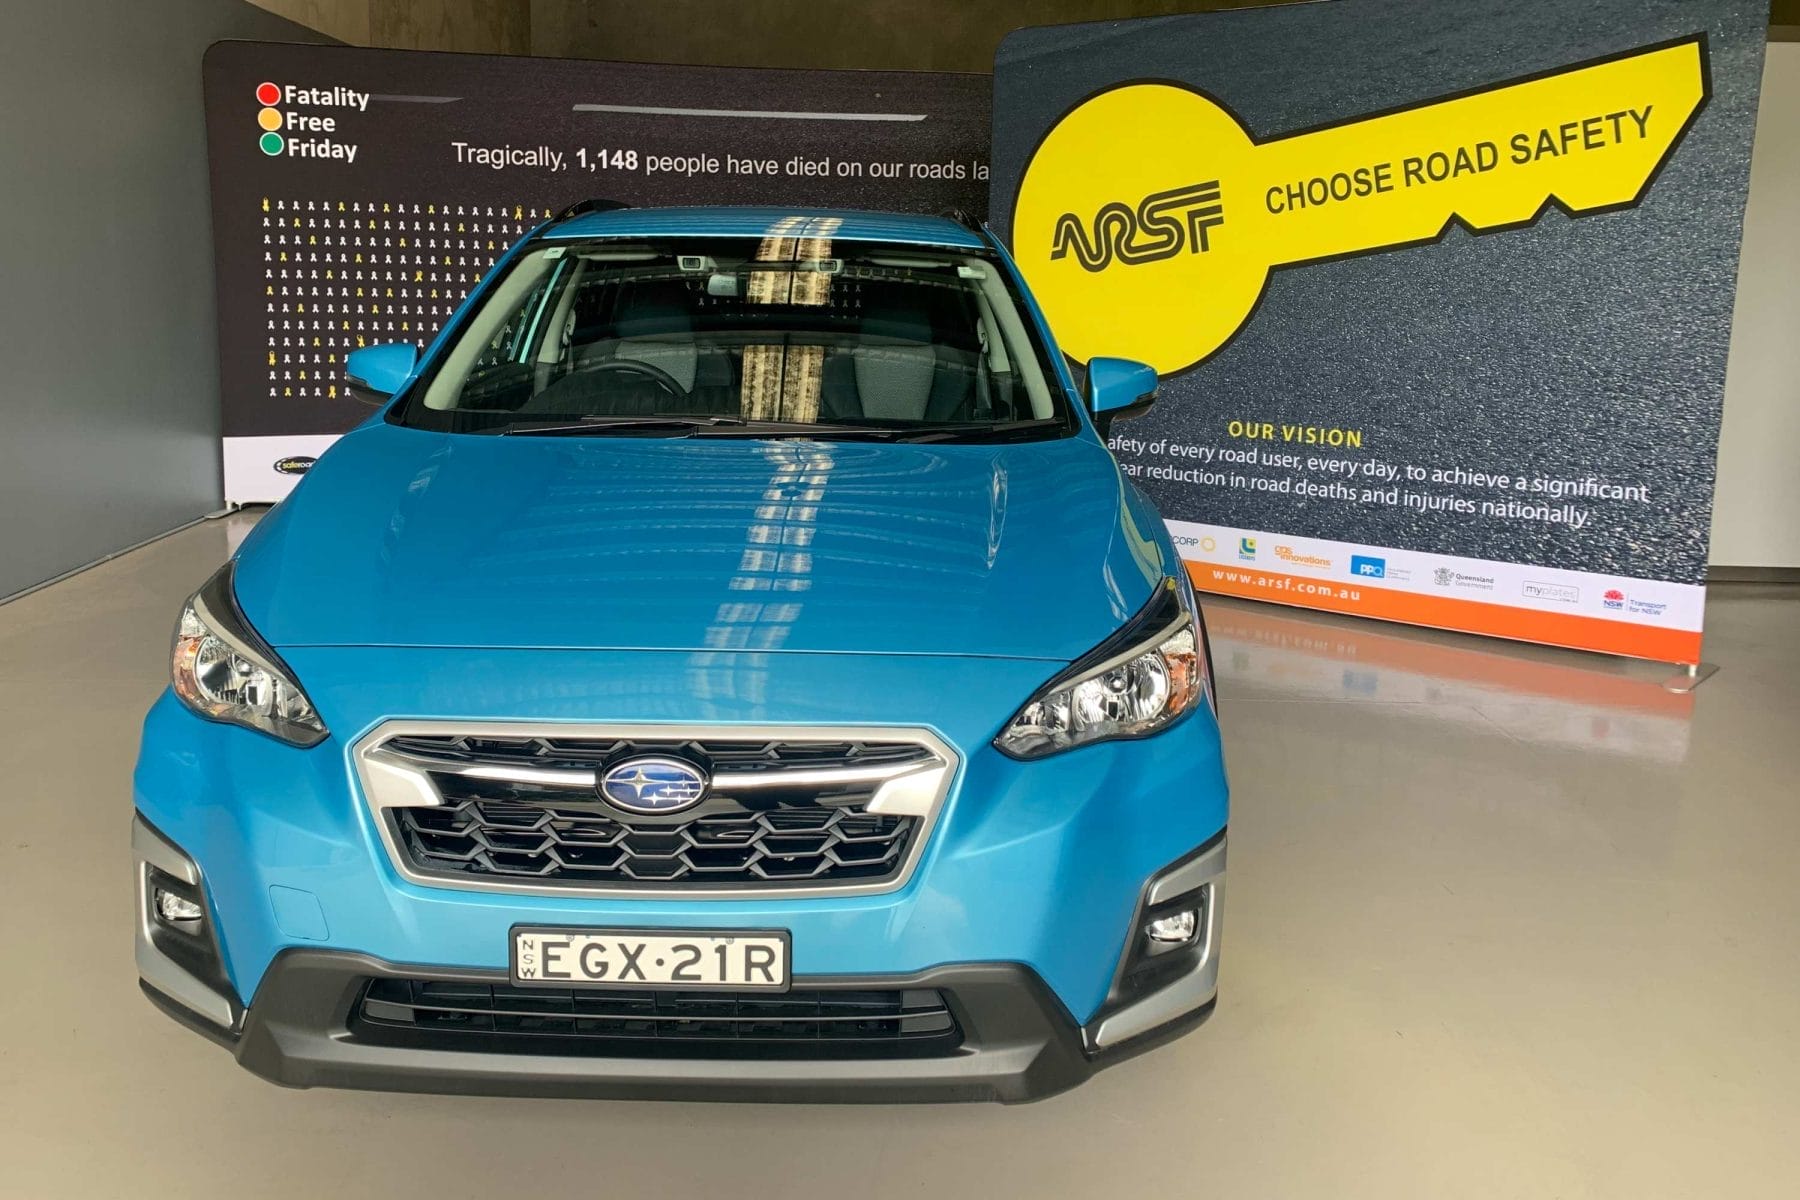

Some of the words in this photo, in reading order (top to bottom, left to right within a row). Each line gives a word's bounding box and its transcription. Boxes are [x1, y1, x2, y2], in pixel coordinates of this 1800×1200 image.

[285, 85, 369, 111] Fatality
[286, 112, 336, 132] Free
[288, 138, 357, 163] Friday
[452, 142, 567, 172] Tragically,
[576, 149, 638, 172] 1,148
[646, 153, 719, 177] people
[727, 155, 779, 175] have
[785, 156, 830, 177] died
[837, 162, 862, 177] on
[869, 163, 904, 178] our
[909, 160, 966, 180] roads
[1264, 163, 1393, 215] CHOOSE
[1404, 141, 1500, 187] ROAD
[1510, 106, 1654, 166] SAFETY
[1228, 421, 1274, 440] OUR
[1282, 425, 1362, 448] VISION
[1149, 439, 1167, 455] of
[1169, 444, 1215, 464] every
[1219, 447, 1257, 465] road
[1263, 454, 1303, 471] user,
[1308, 457, 1360, 478] every
[1363, 459, 1400, 481] day,
[1406, 464, 1427, 480] to
[1431, 466, 1510, 489] achieve
[1515, 477, 1527, 491] a
[1533, 476, 1650, 501] significant
[1147, 465, 1226, 485] reduction
[1230, 471, 1246, 488] in
[1250, 475, 1290, 494] road
[1295, 479, 1357, 501] deaths
[1362, 486, 1398, 505] and
[1404, 491, 1476, 515] injuries
[1482, 500, 1592, 529] nationally.
[1360, 563, 1383, 577] PPQ
[1455, 573, 1495, 584] Queensland
[1213, 569, 1361, 601] www.arsf.com.au
[1603, 600, 1623, 608] NSW
